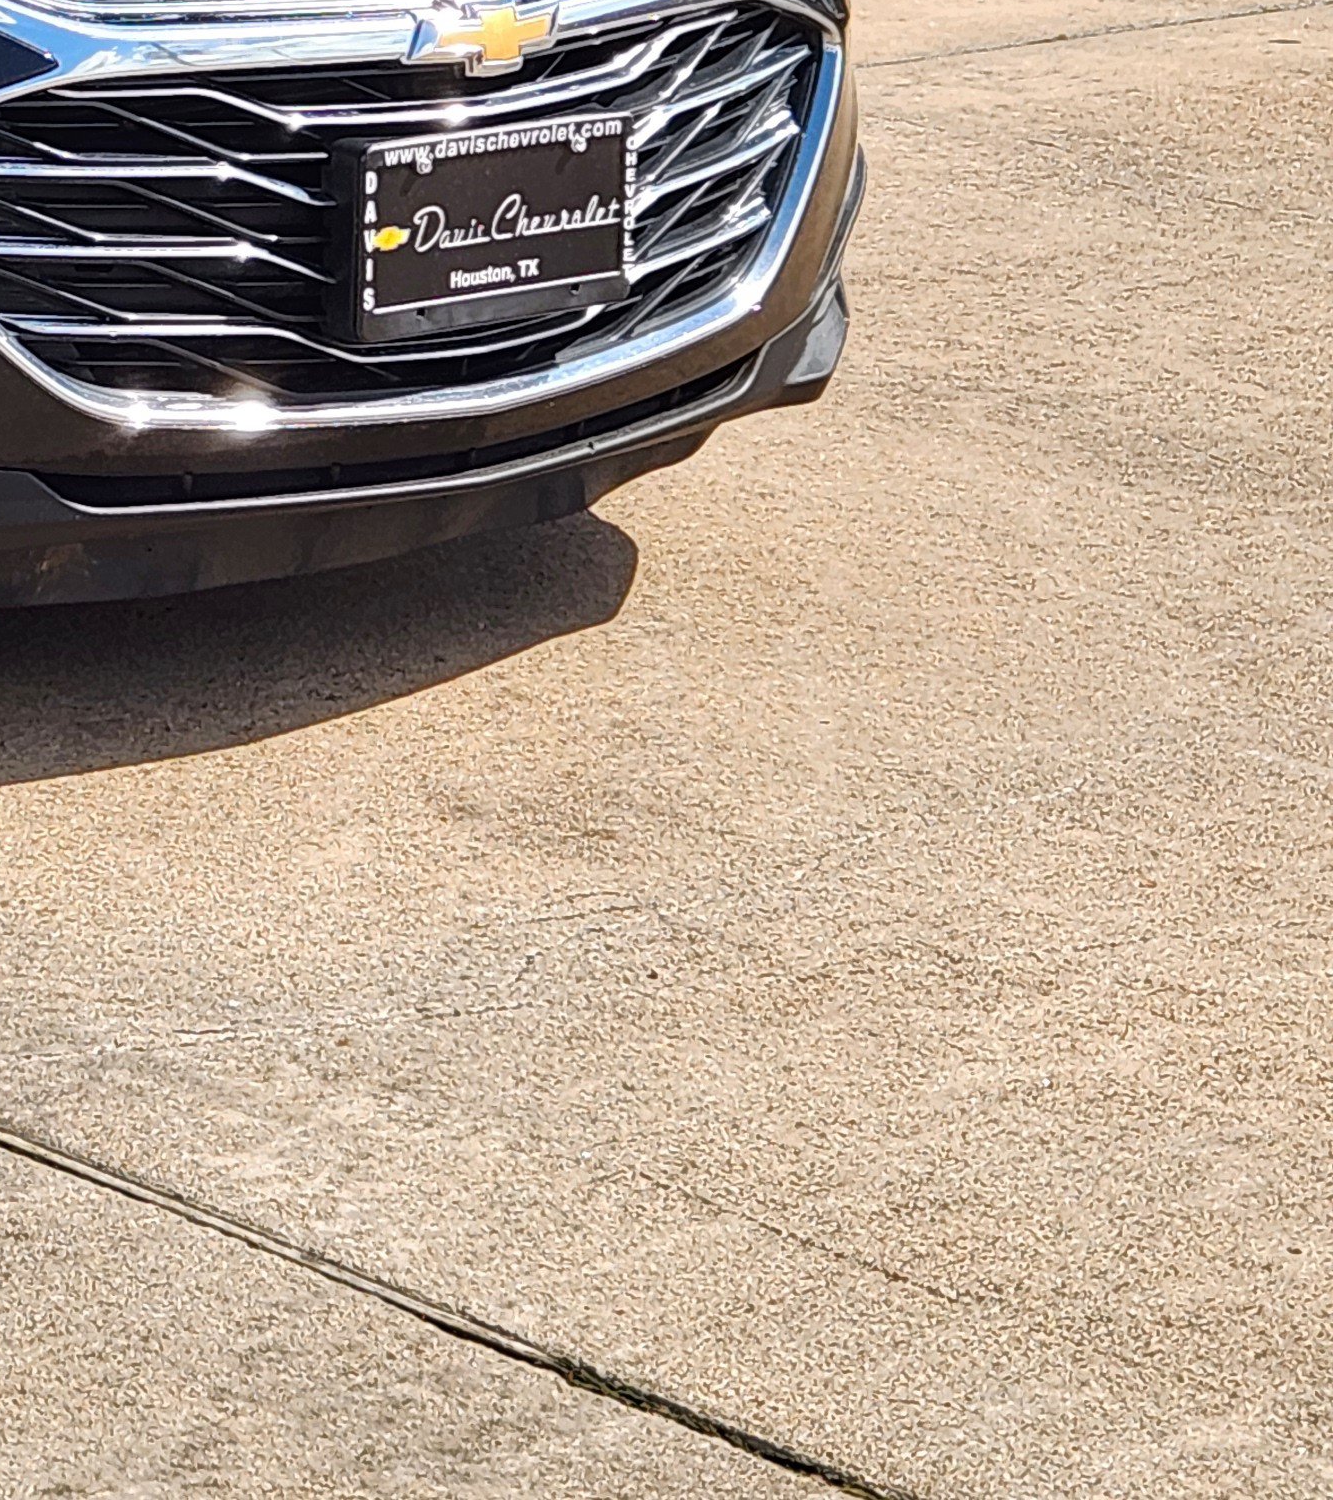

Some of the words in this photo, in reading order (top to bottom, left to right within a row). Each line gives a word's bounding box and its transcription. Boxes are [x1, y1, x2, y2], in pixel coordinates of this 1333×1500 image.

[383, 118, 623, 167] www.davischevrolet.com
[363, 171, 378, 311] DAVIS
[413, 204, 492, 253] Davis
[490, 193, 621, 241] Chevrolet
[450, 263, 516, 289] Houston,
[517, 257, 540, 278] TX
